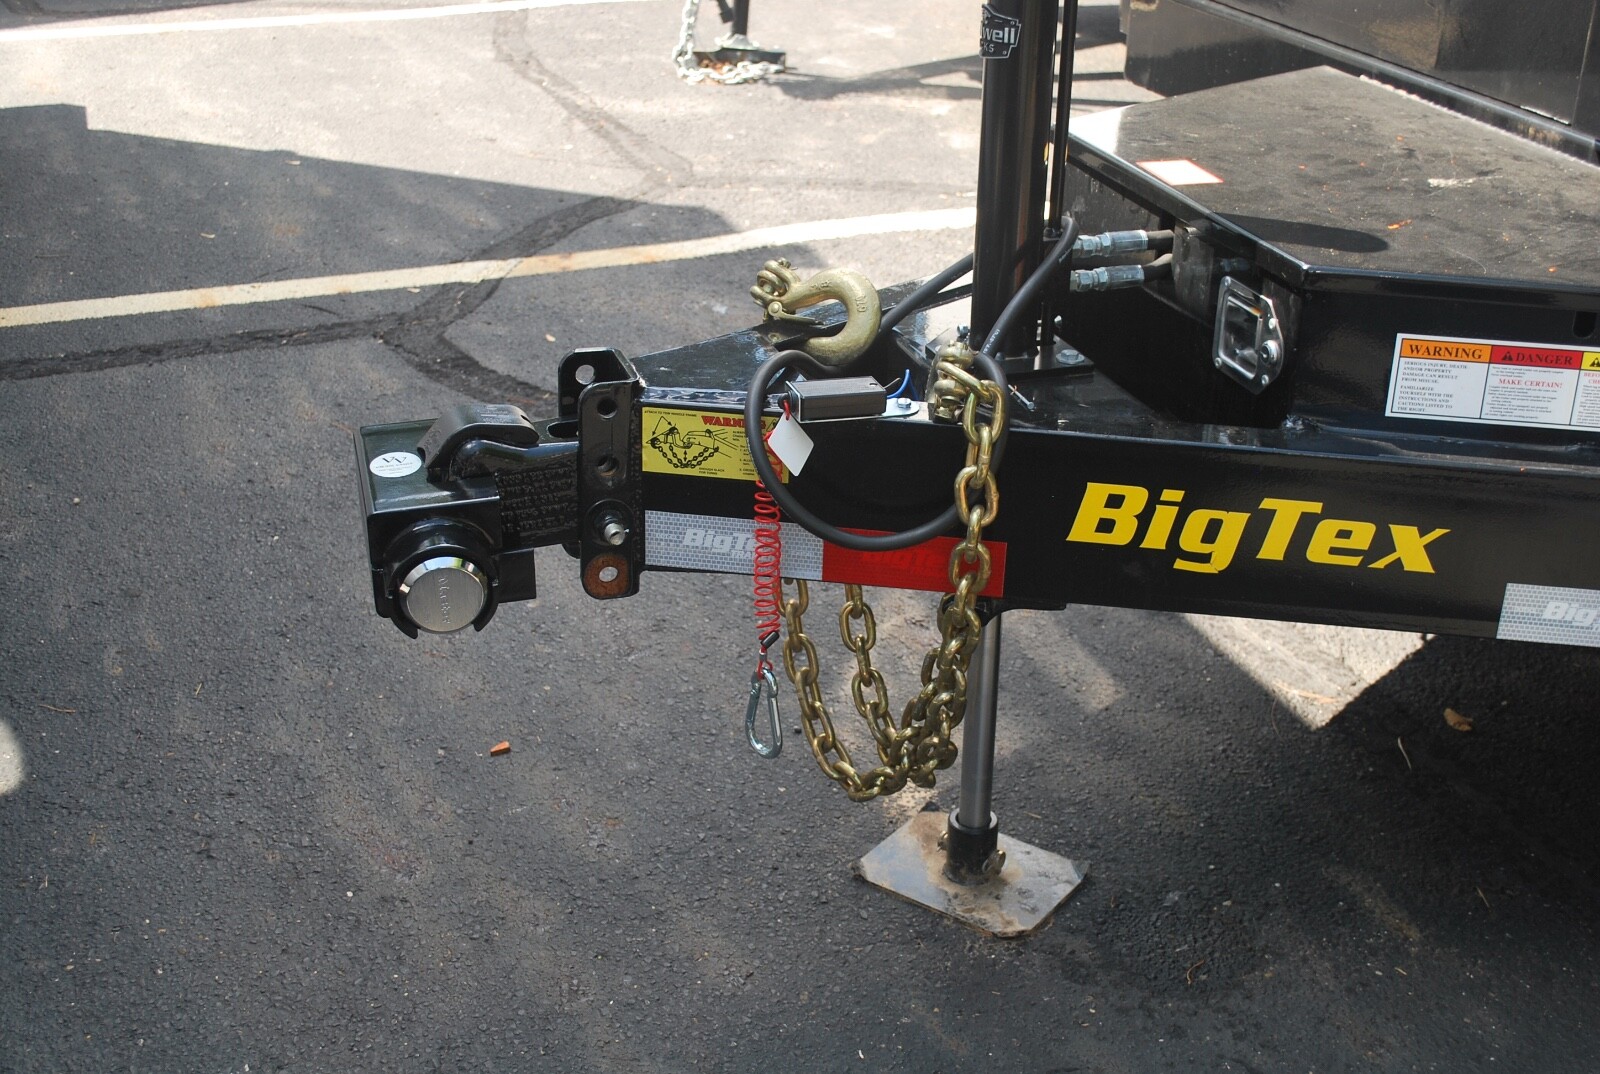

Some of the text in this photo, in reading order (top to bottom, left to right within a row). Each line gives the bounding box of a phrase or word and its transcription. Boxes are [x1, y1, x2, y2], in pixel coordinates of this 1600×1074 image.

[1409, 344, 1483, 360] WARNING
[1516, 352, 1573, 366] DANGER
[701, 415, 767, 430] WARNG
[1066, 481, 1451, 574] BigTex
[682, 528, 778, 553] BigT
[1542, 601, 1600, 627] Big
